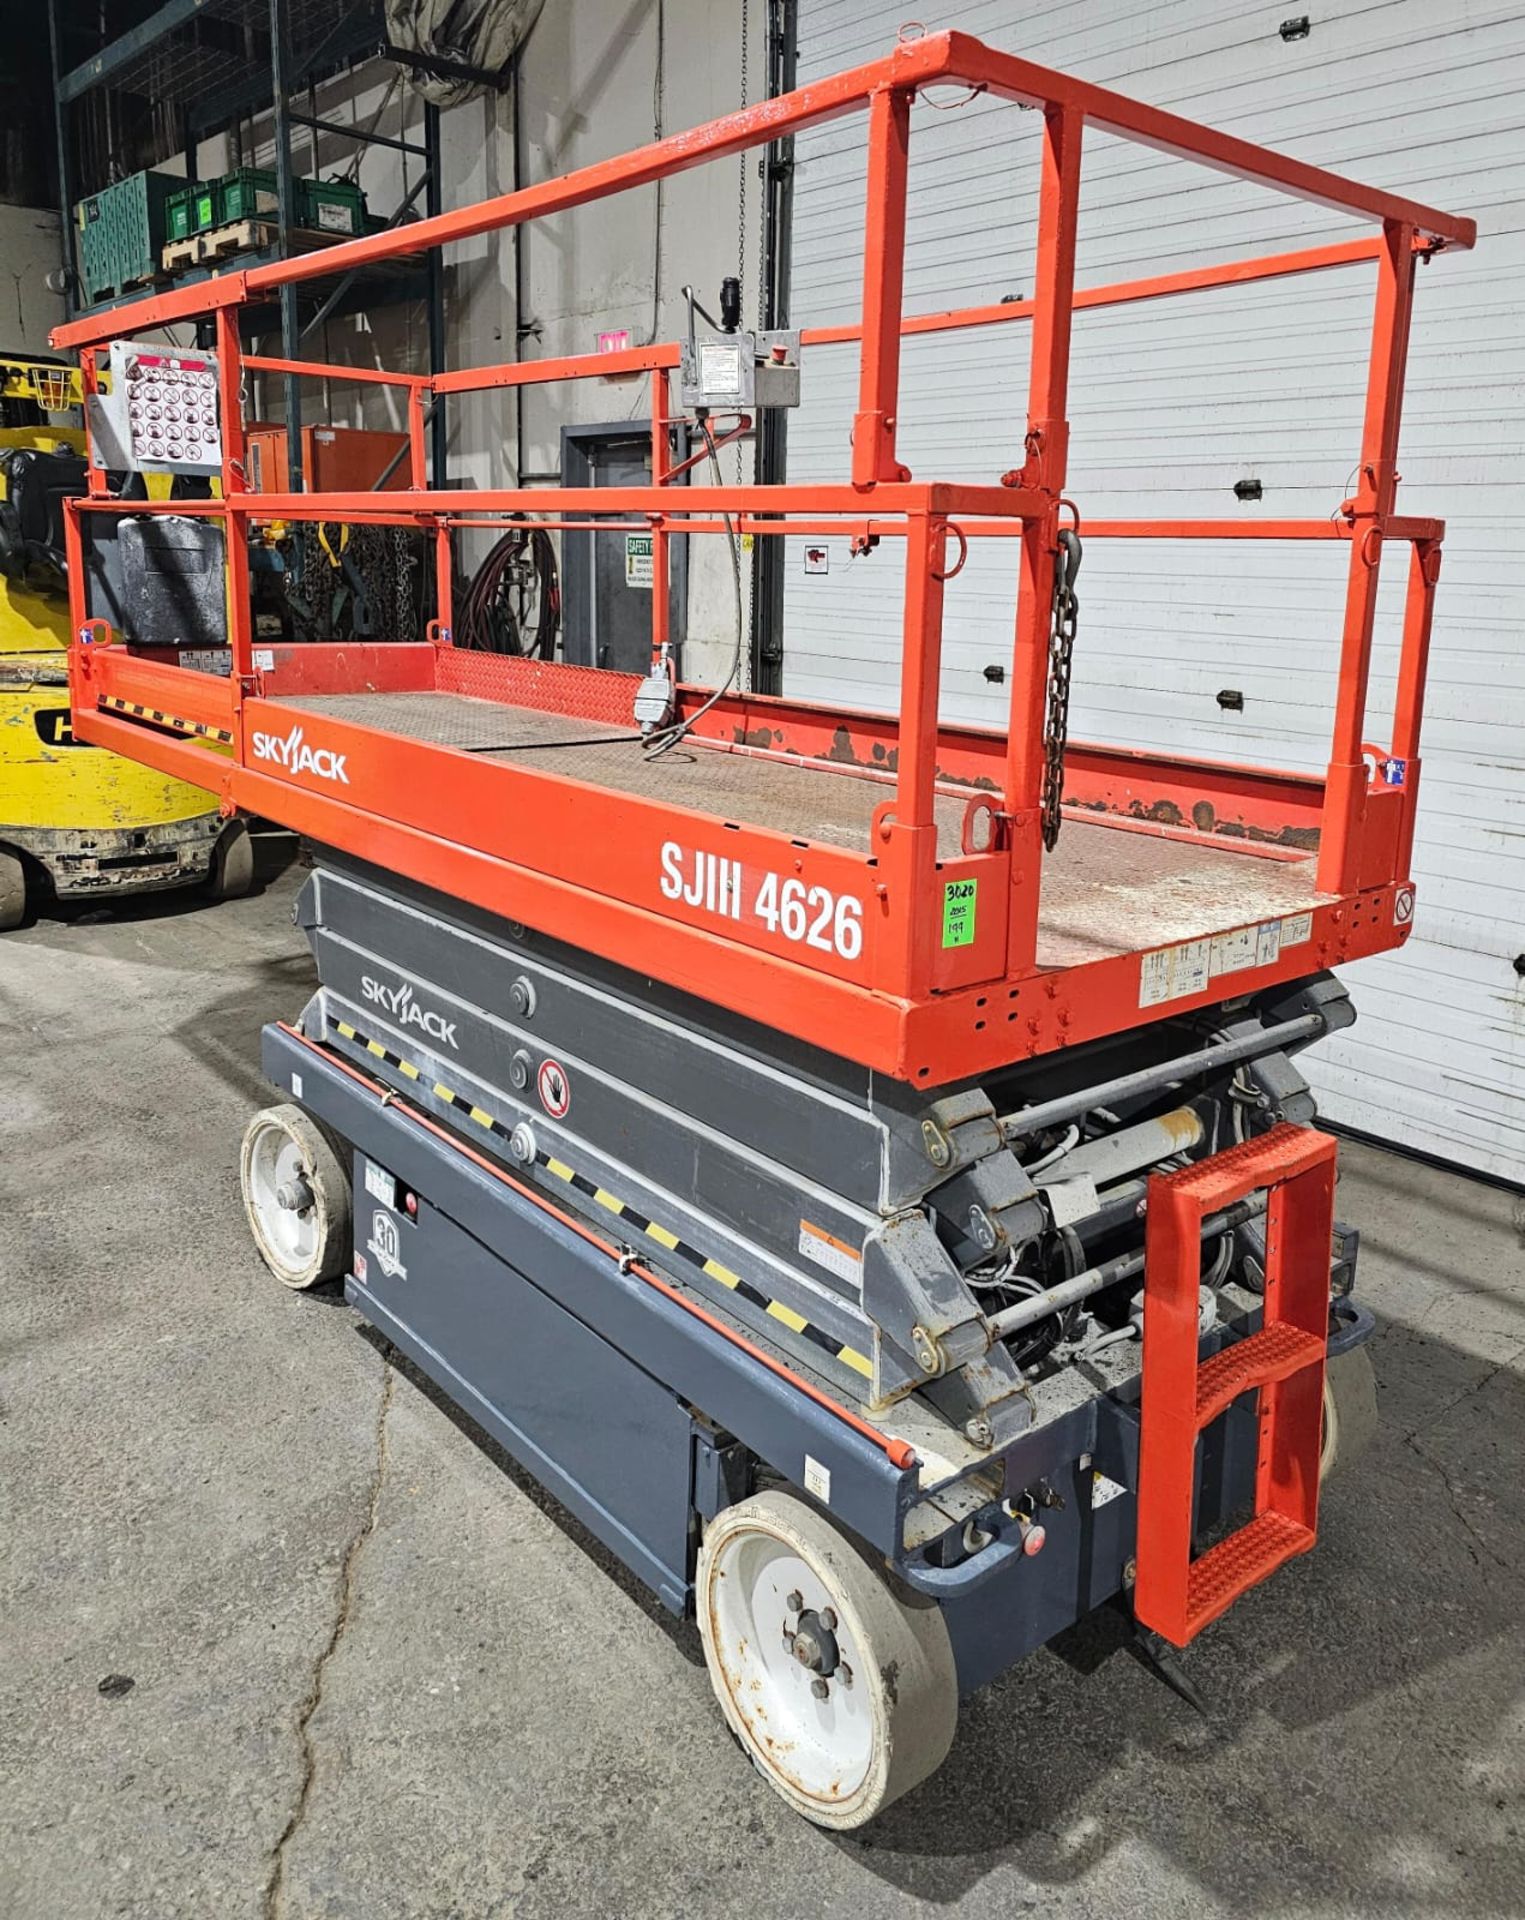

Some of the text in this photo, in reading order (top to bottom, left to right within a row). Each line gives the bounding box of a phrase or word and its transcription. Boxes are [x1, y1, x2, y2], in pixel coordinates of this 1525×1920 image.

[628, 539, 649, 554] SAFETY
[252, 725, 350, 785] SKYJACK
[754, 872, 863, 960] 4626
[947, 884, 974, 901] 3020
[361, 976, 459, 1050] SKYJACK
[376, 1215, 397, 1259] 30
